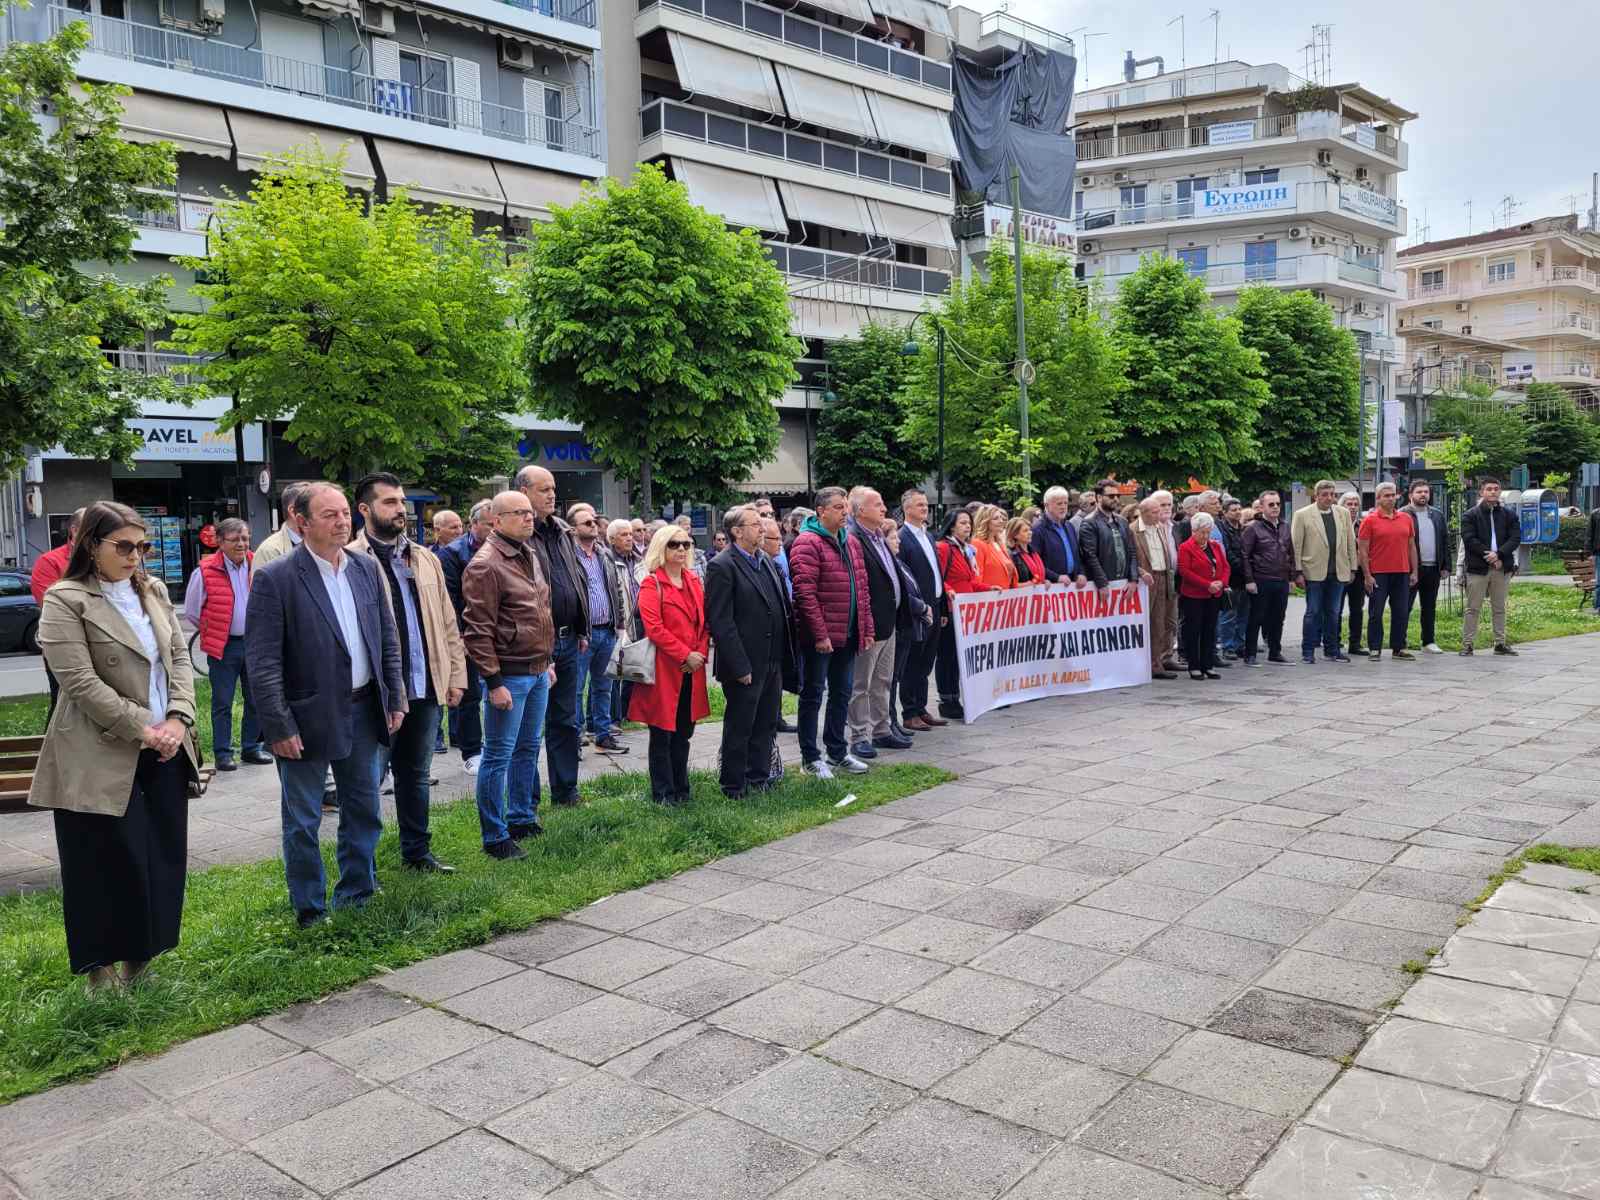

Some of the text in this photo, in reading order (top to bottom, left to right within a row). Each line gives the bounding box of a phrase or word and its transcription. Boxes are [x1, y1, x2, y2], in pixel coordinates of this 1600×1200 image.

[127, 427, 198, 446] RAVEL
[164, 447, 190, 455] TICKETS
[965, 641, 994, 678] ΜΕΡΑ
[997, 633, 1057, 668] ΜΝΗΜΗΣ
[1081, 624, 1144, 655] ΑΓΩΝΩΝ
